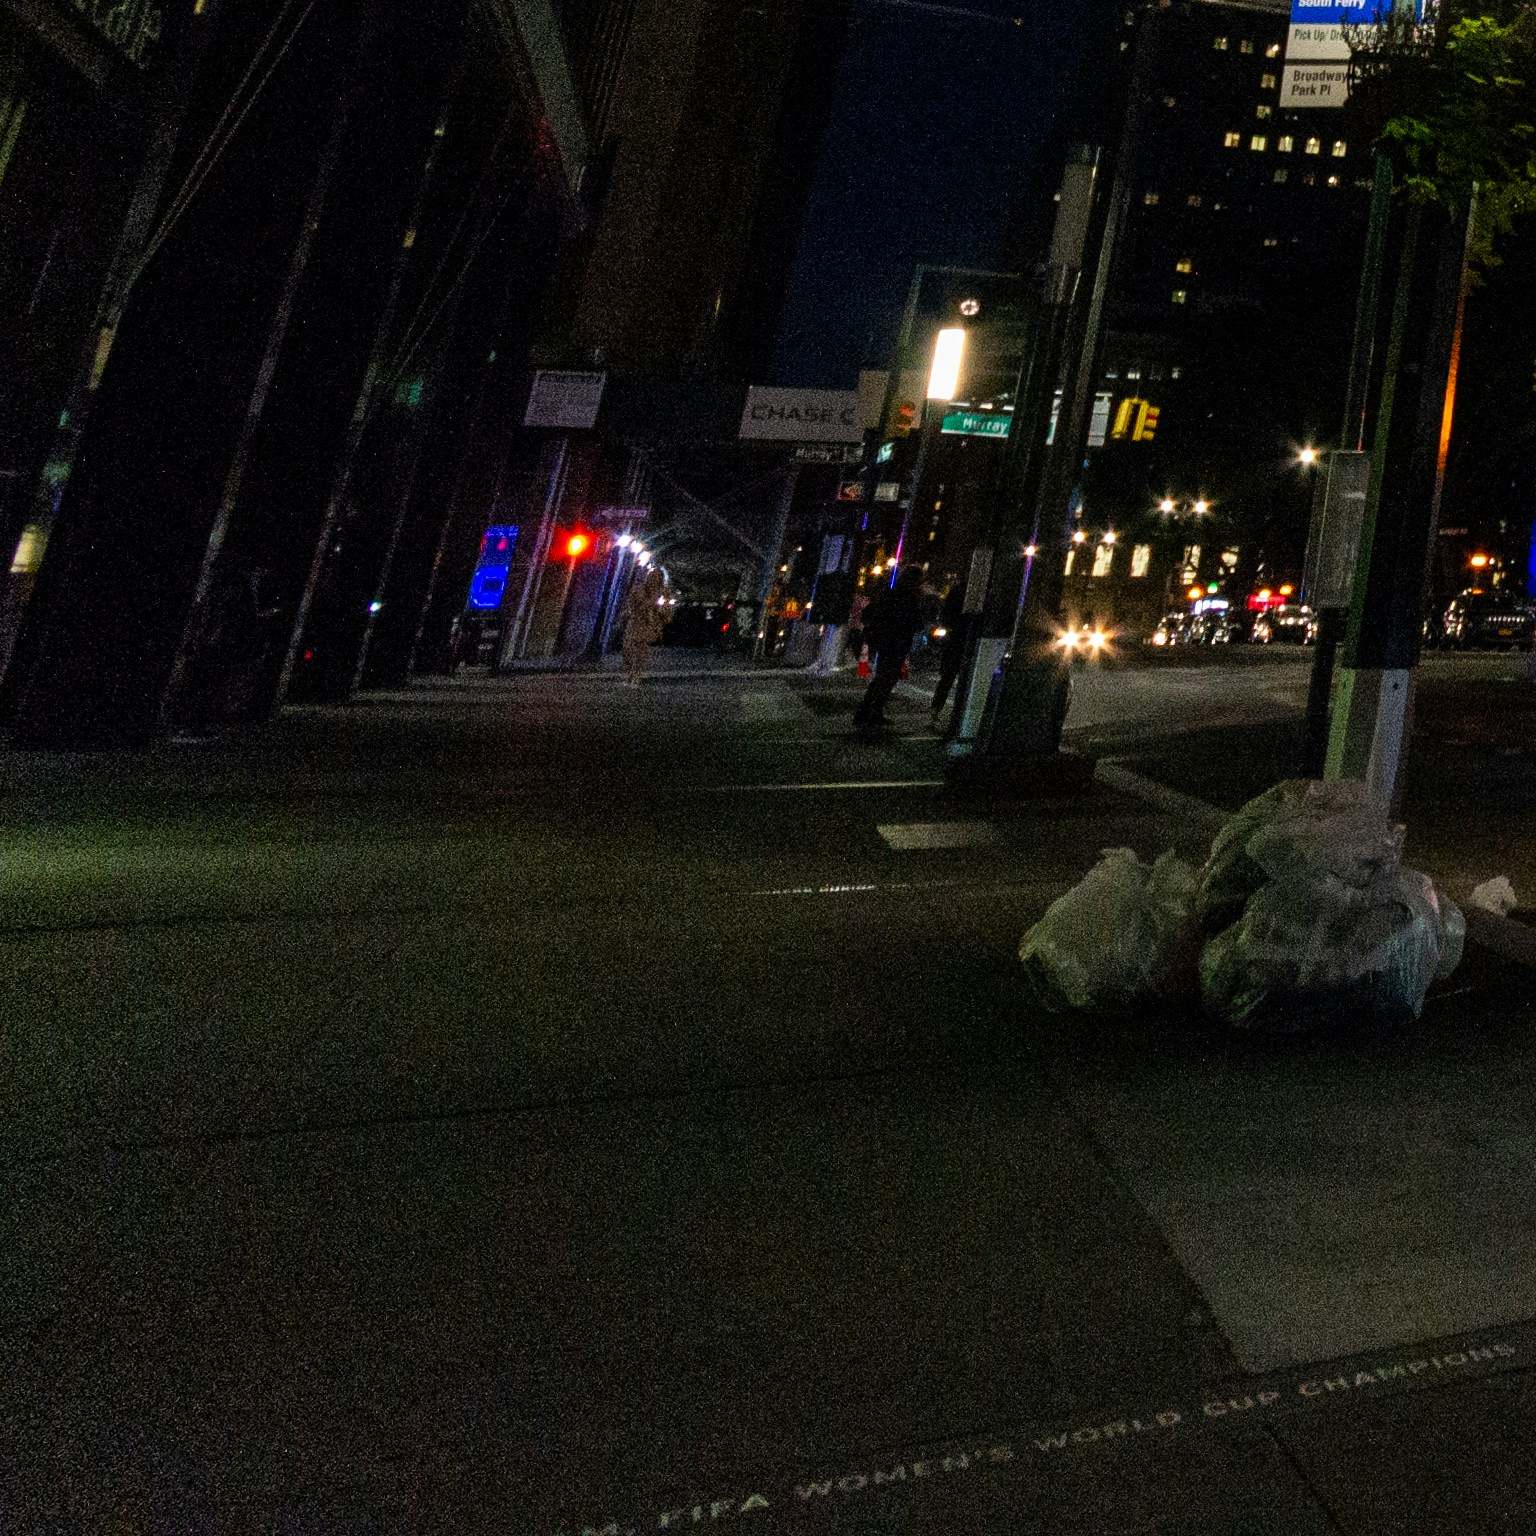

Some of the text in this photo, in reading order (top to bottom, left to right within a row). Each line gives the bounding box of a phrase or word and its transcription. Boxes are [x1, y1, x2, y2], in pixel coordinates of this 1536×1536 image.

[1294, 29, 1312, 41] Pick
[1293, 70, 1348, 83] Broadway
[1291, 83, 1316, 96] Park
[751, 405, 833, 423] CHASE
[658, 1340, 1517, 1530] FIFA WOMEN'S WORLD CUP CHAMPIONS
